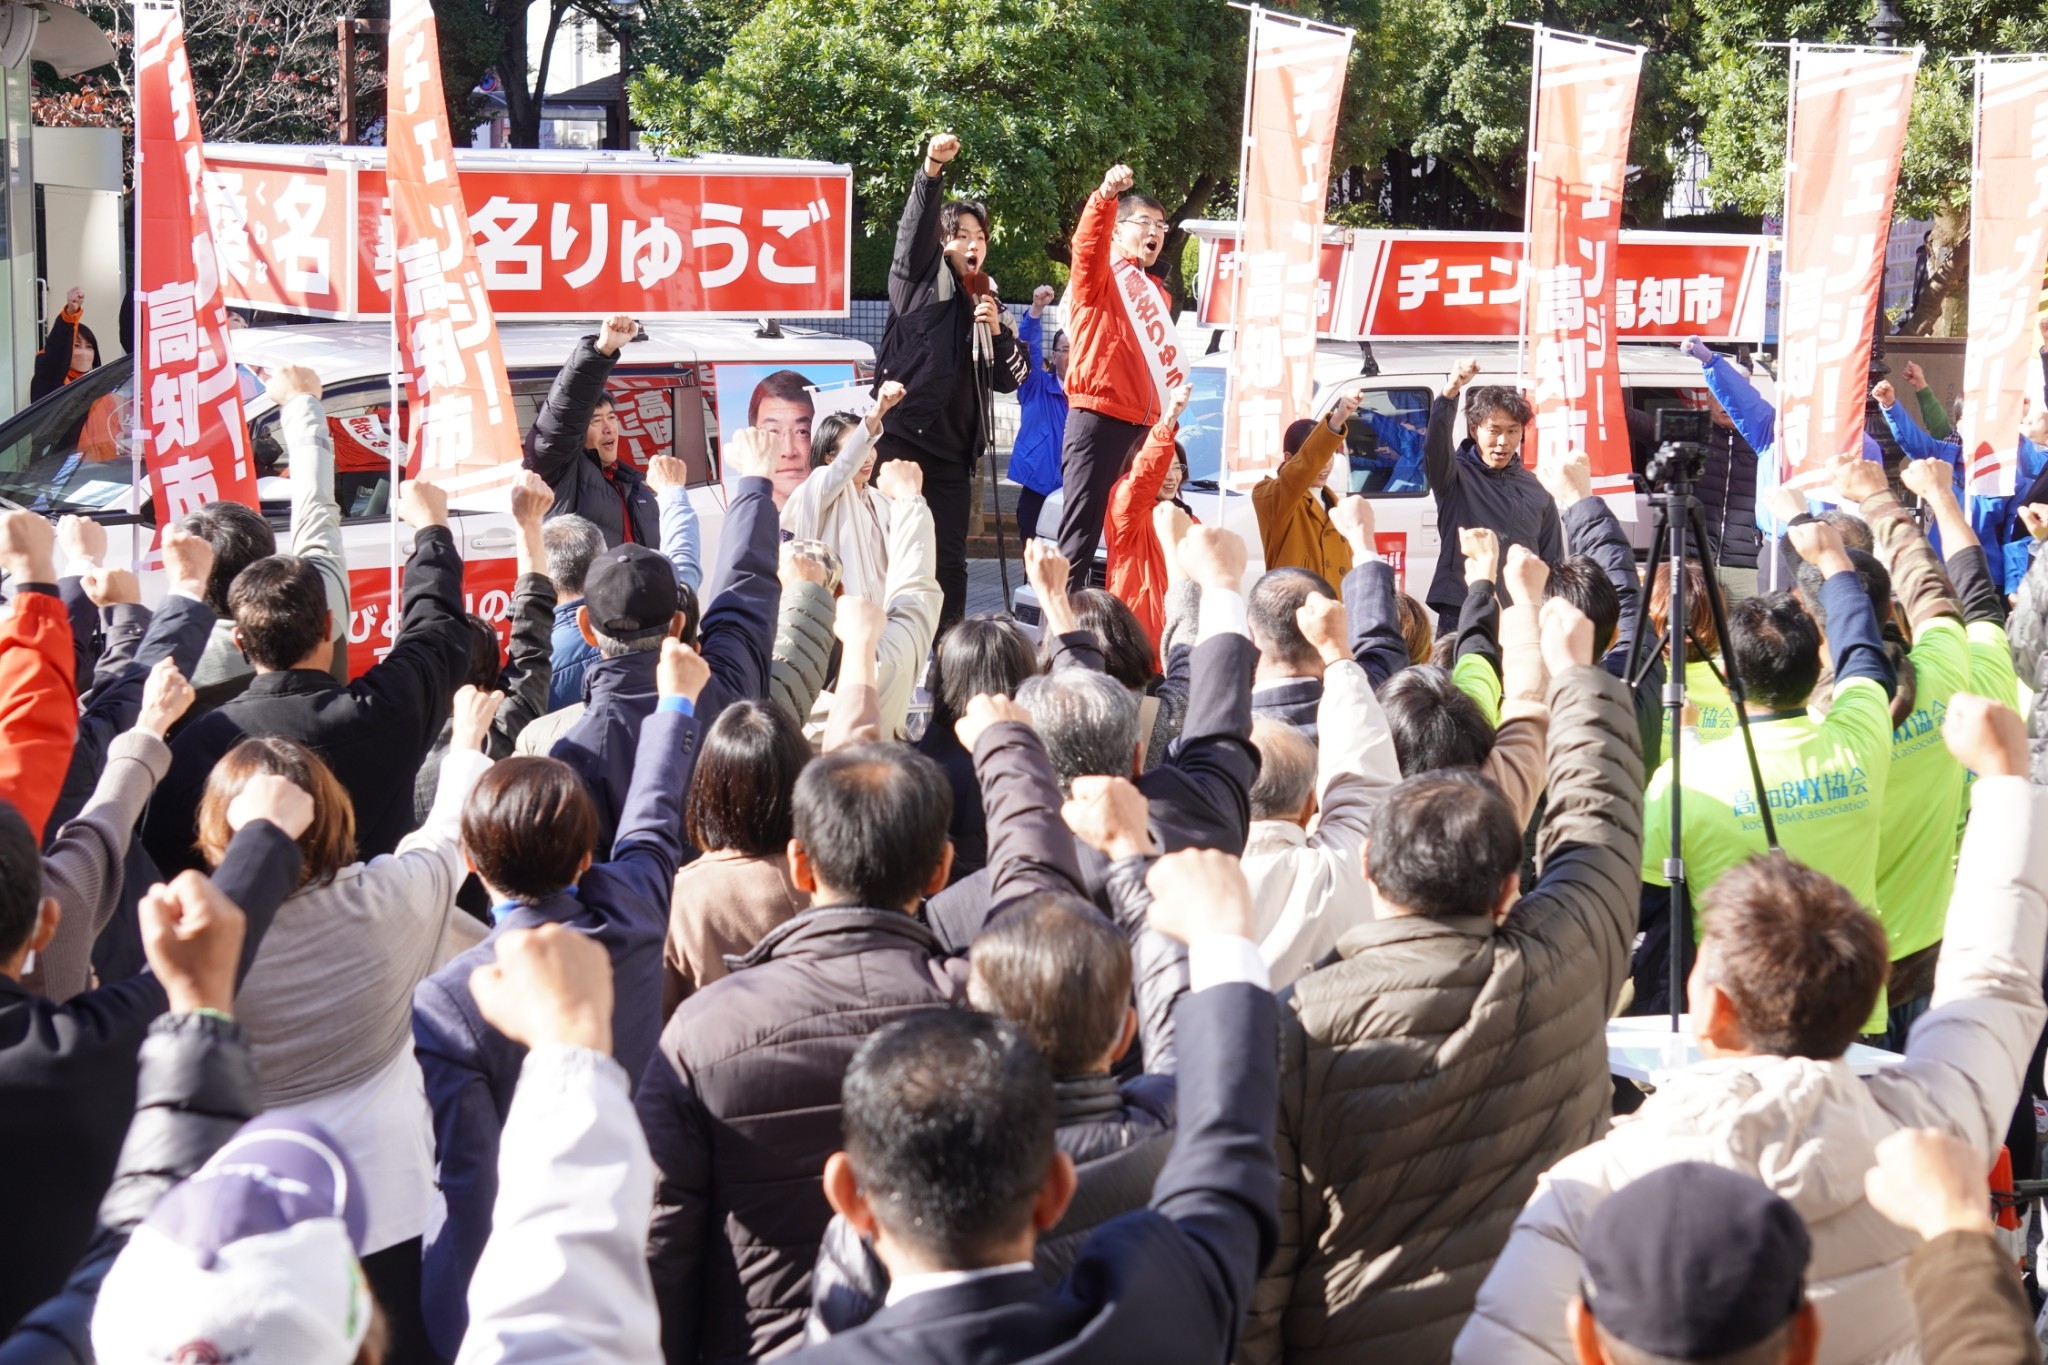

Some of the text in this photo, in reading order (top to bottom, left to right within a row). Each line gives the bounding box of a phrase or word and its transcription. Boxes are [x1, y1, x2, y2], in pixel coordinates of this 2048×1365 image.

[374, 197, 831, 290] 名りゅうご
[1124, 270, 1183, 388] 桑名りゅう
[1817, 85, 1901, 432] チェンジ！
[147, 280, 219, 524] 高知市
[397, 236, 473, 470] 高知市
[1239, 250, 1287, 463] 高知市
[1536, 265, 1587, 457] 高知市
[1777, 810, 1806, 825] BMX
[1807, 798, 1870, 820] association
